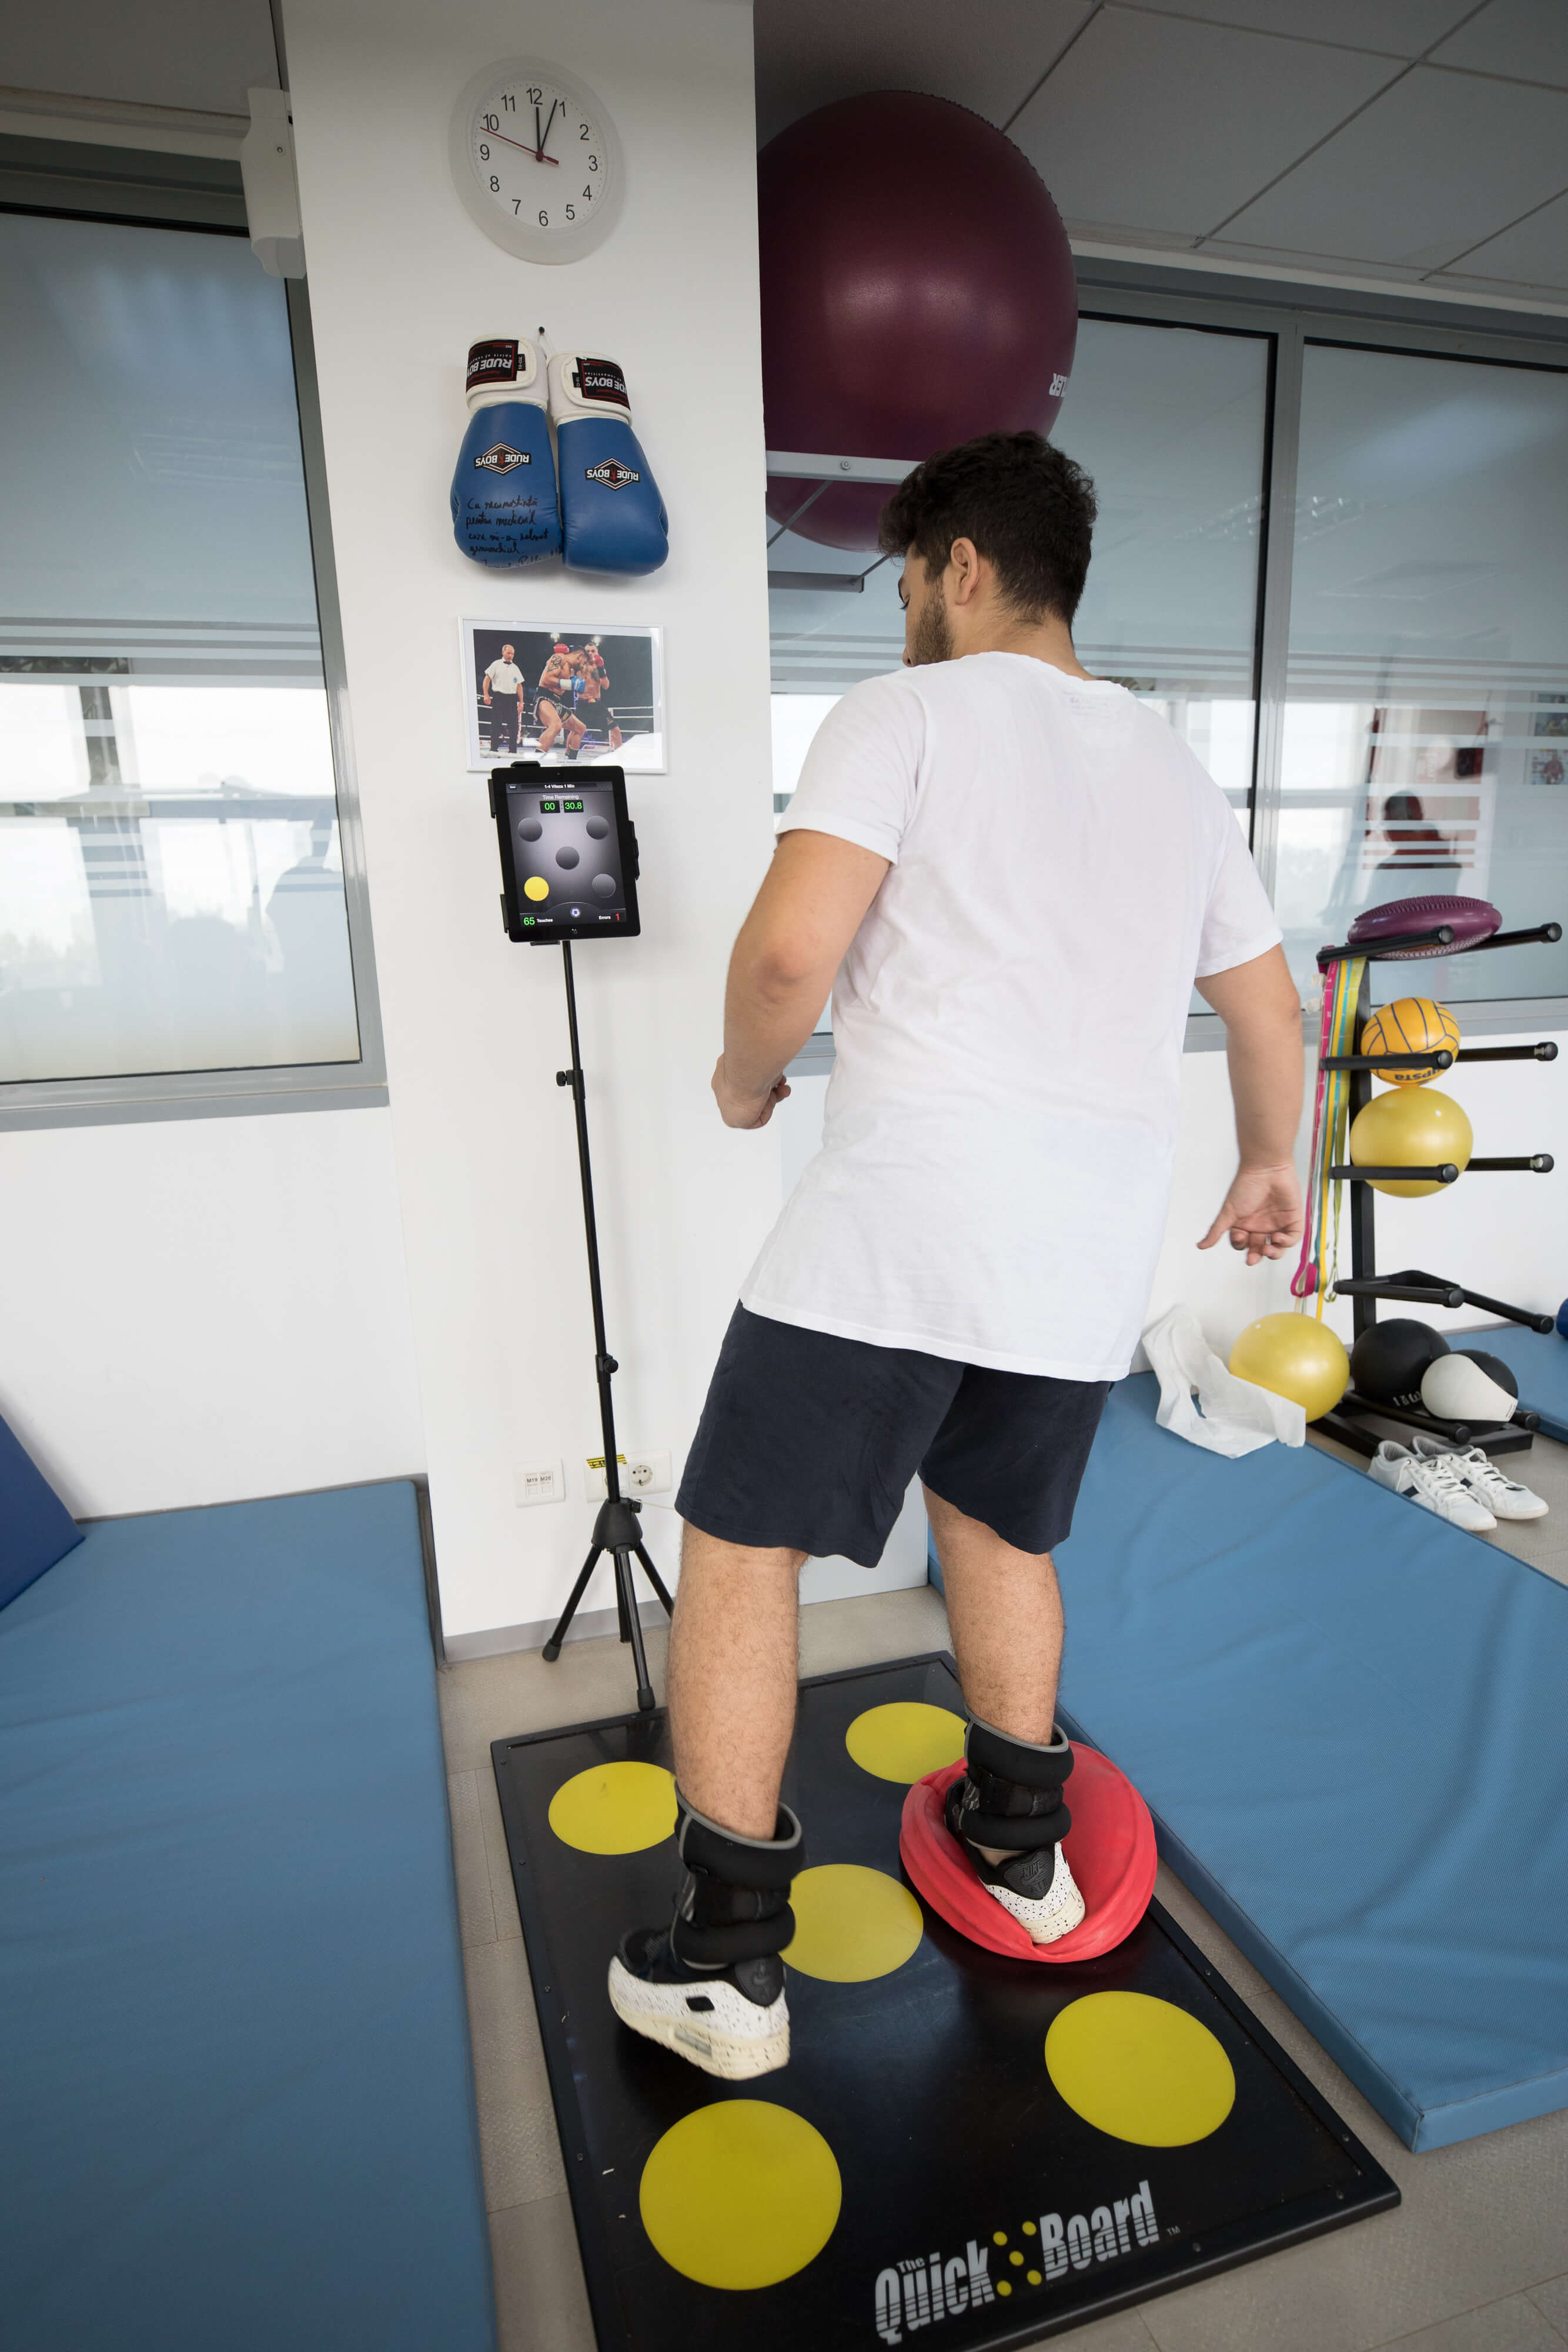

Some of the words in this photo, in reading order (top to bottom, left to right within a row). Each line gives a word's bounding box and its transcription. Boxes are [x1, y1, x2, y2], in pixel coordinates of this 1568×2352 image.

[501, 95, 516, 112] 11
[527, 88, 543, 105] 12
[559, 101, 566, 118] 1
[483, 113, 499, 131] 10
[580, 124, 590, 141] 2
[480, 144, 490, 161] 9
[589, 155, 598, 171] 3
[490, 176, 500, 192] 8
[583, 185, 592, 201] 4
[512, 199, 521, 215] 7
[566, 205, 575, 220] 5
[539, 211, 549, 226] 6
[479, 358, 513, 369] RUDE
[584, 376, 613, 387] BOYS
[475, 455, 497, 467] BOYS
[504, 454, 529, 463] RUDE
[587, 469, 610, 479] BOYS
[617, 470, 639, 481] RUDE
[544, 802, 556, 810] 00
[564, 801, 583, 810] 30.8
[523, 917, 536, 926] 65
[616, 913, 620, 921] 1
[1024, 1861, 1046, 1879] NIKE
[875, 2240, 995, 2346] Quick
[1040, 2180, 1160, 2281] Board
[897, 2256, 925, 2274] The
